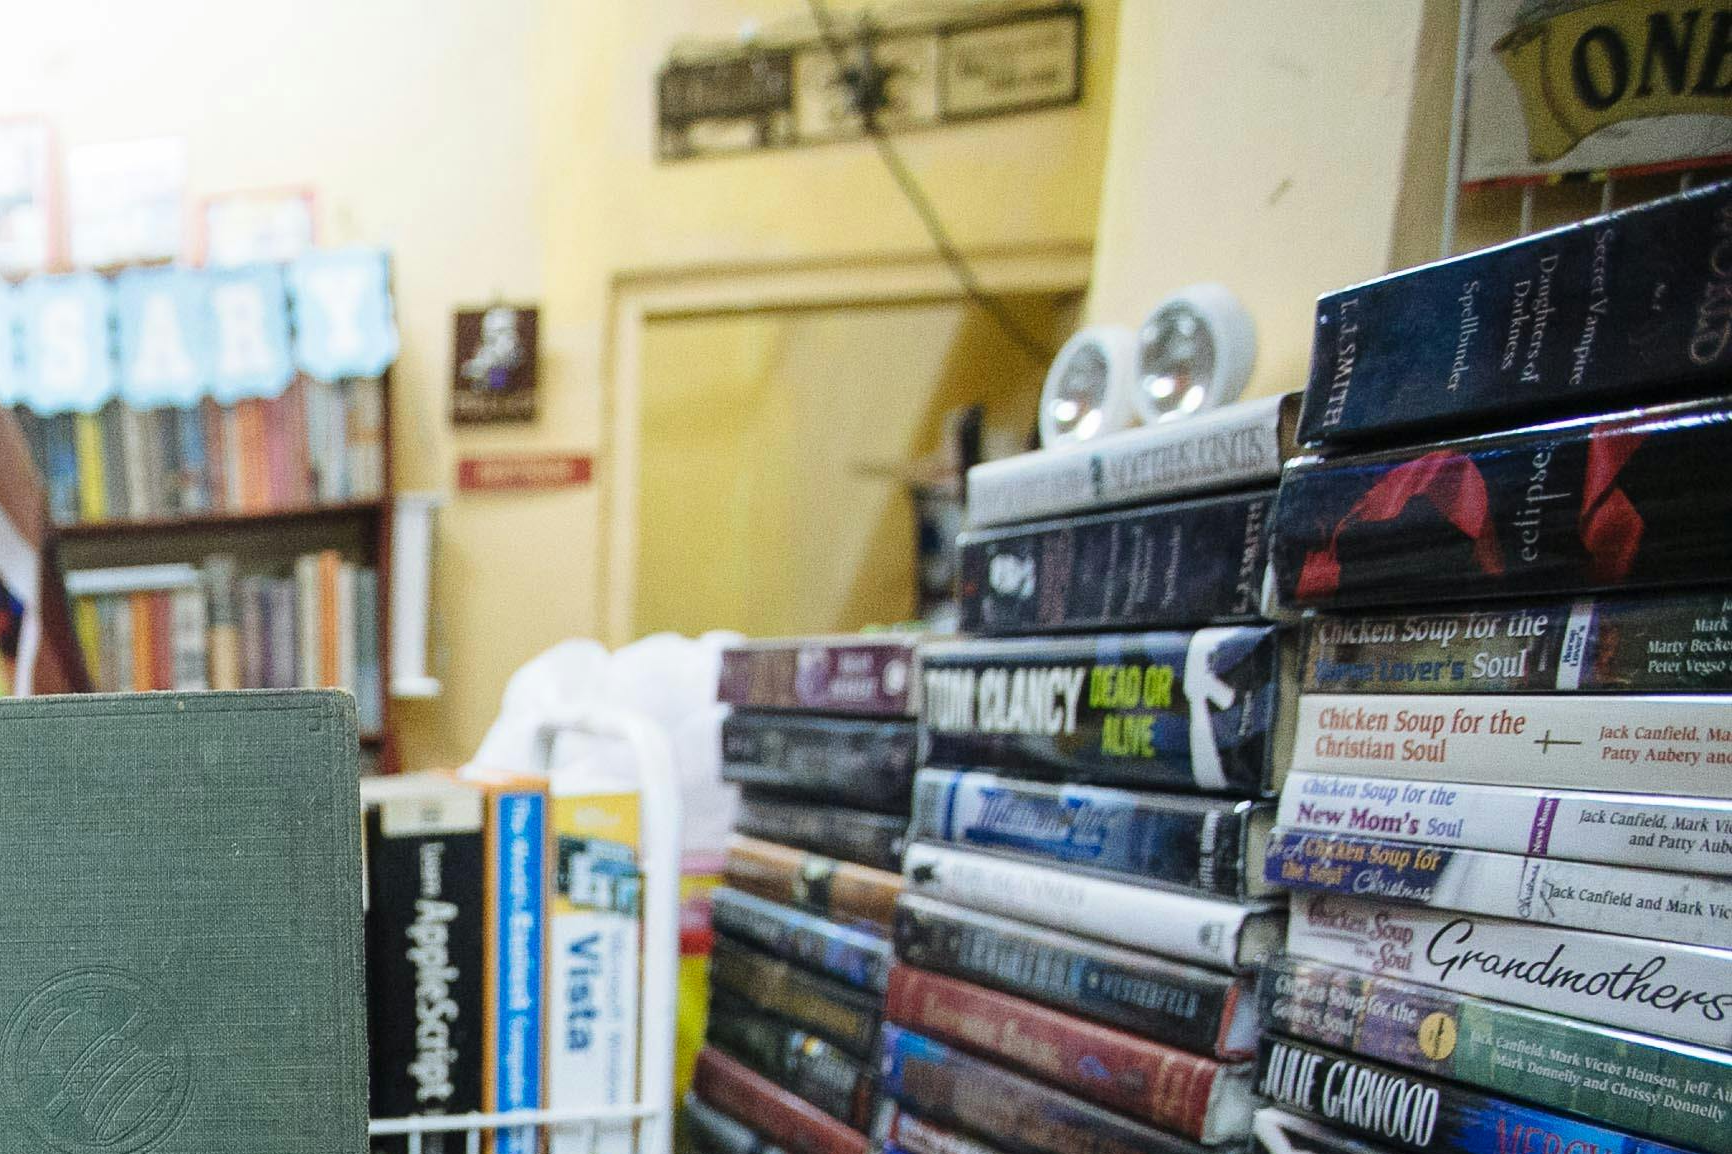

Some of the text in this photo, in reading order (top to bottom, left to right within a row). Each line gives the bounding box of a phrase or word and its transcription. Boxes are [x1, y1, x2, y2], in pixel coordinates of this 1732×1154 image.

[1500, 279, 1532, 371] Darkness
[1519, 254, 1561, 384] Daughters of
[1569, 228, 1616, 387] Secret Vampire
[1447, 279, 1481, 393] Spellbinder
[1322, 343, 1357, 428] SMITH
[1513, 443, 1572, 562] eclipse
[1318, 610, 1550, 648] Chicken Soup for the
[1692, 617, 1729, 633] Mark
[1379, 650, 1528, 682] Lover's Soul
[1647, 639, 1687, 657] Marty
[1647, 659, 1682, 675] Peter
[978, 664, 1087, 736] CLANCY
[1144, 664, 1174, 708] OR
[1102, 714, 1156, 758] ALIVE
[1317, 705, 1527, 738] Chicken Soup for the
[1598, 724, 1702, 743] Jack Canfield,
[1314, 734, 1448, 763] Christian Soul
[1601, 746, 1701, 766] Patty Aubery
[1301, 776, 1458, 807] Chicken Soup for the
[1296, 803, 1464, 840] New Mom's Soul
[1577, 808, 1607, 826] Jack
[1609, 810, 1668, 830] Canfield,
[1670, 816, 1707, 833] Mark
[1305, 837, 1443, 872] Chicken Soup for
[1629, 831, 1698, 853] and Patty
[1351, 869, 1433, 904] Christmas
[1548, 882, 1576, 902] Jack
[1578, 888, 1633, 908] Canfield
[1636, 894, 1663, 911] and
[1665, 898, 1706, 916] Mark
[1372, 911, 1415, 944] Soup
[1371, 944, 1415, 974] Soul
[1425, 918, 1732, 1022] Grandmothers
[405, 898, 460, 1101] AppleScript
[564, 930, 604, 1054] Vista
[1495, 1035, 1546, 1060] Canfield,
[1548, 1048, 1582, 1068] Mark
[1583, 1055, 1624, 1077] Victor
[1626, 1065, 1682, 1092] Hansen,
[1683, 1077, 1713, 1100] Jeff
[1260, 1042, 1440, 1148] JULIE GARWOOD
[1493, 1052, 1728, 1125] Mark Donnelly and Chrissy Donnelly
